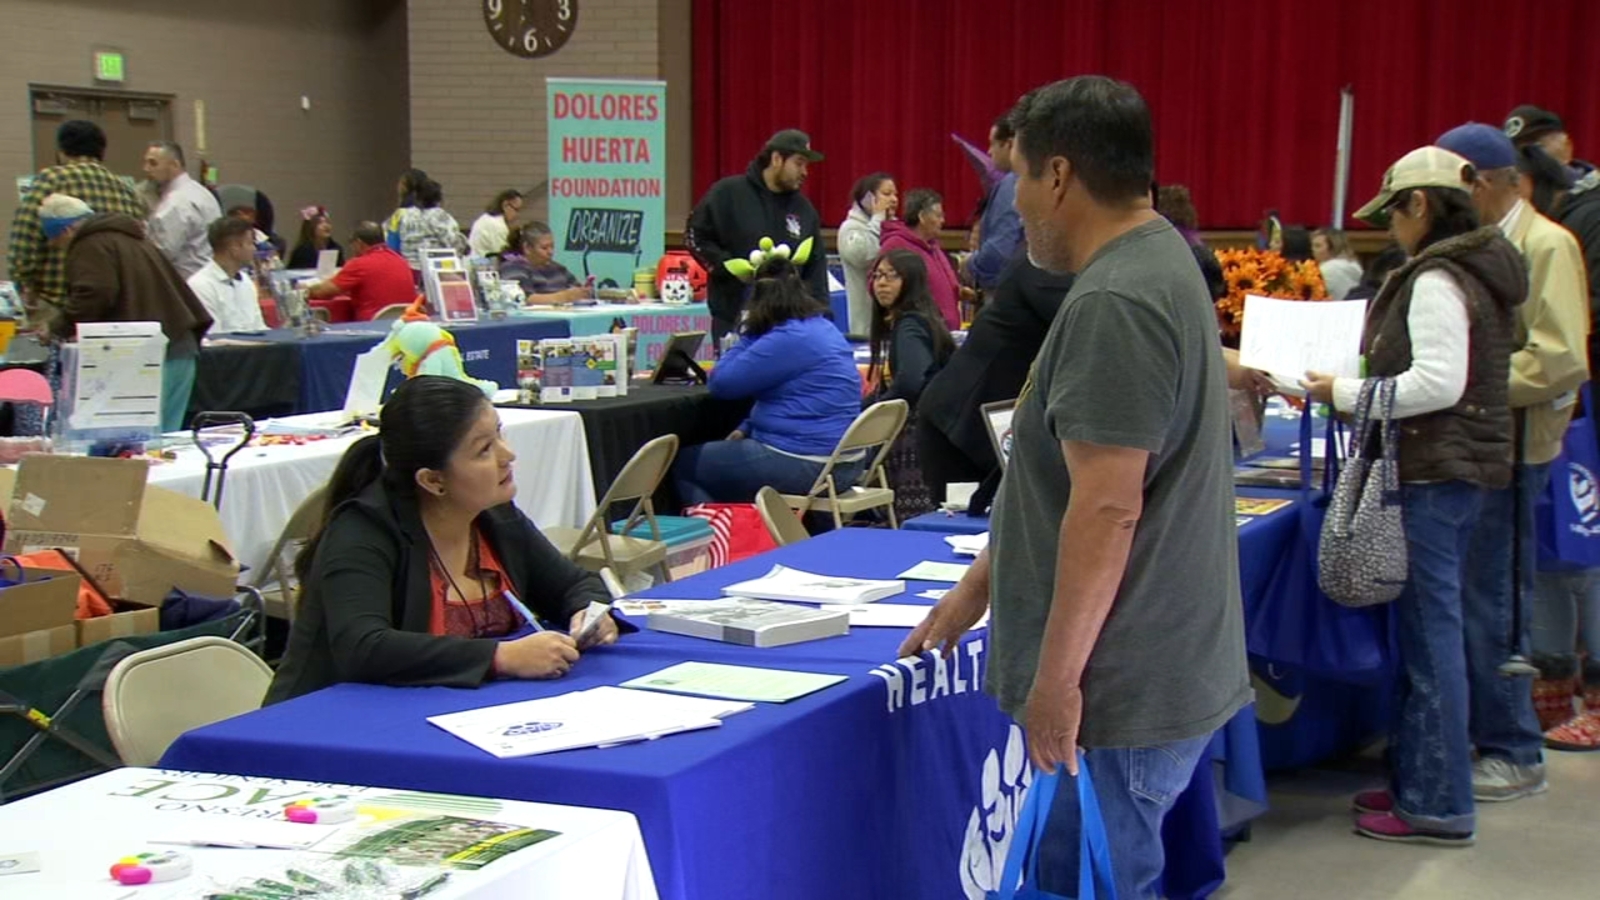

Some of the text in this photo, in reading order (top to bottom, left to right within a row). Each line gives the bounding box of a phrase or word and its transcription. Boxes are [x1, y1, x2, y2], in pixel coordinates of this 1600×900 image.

[488, 0, 502, 20] 9
[558, 0, 571, 20] 3
[524, 28, 538, 52] 6
[554, 92, 659, 122] DOLORES
[562, 136, 650, 164] HUERTA
[551, 177, 661, 198] FOUNDATION
[569, 209, 641, 246] ORGANIZE
[867, 639, 986, 713] HEALT
[107, 779, 310, 807] ACE
